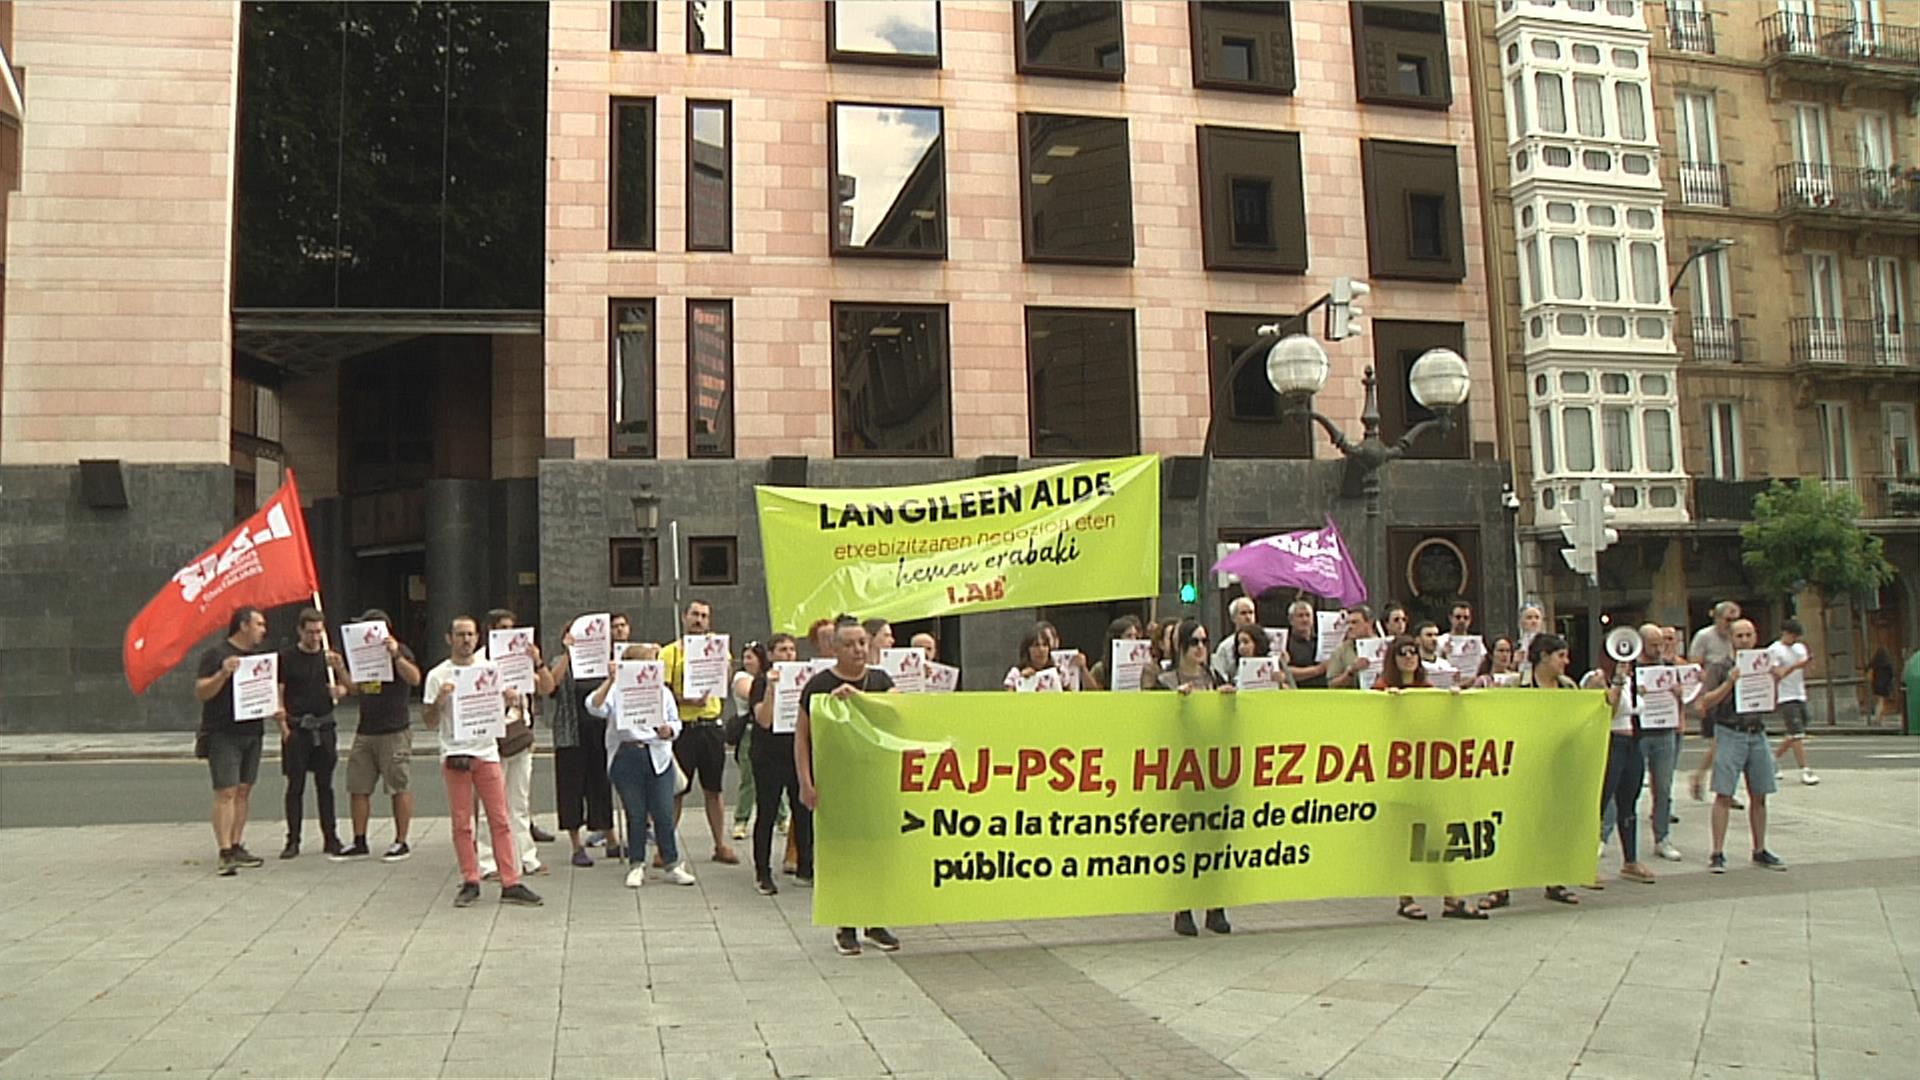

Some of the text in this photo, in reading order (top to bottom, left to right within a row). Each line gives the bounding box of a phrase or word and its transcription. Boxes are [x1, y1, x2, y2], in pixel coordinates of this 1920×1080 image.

[820, 472, 1115, 530] LANGILEEN ALDE
[1075, 514, 1115, 531] eten
[834, 534, 972, 560] etxebizitzaren
[985, 532, 1080, 565] erabaki
[900, 739, 1514, 797] EAJ-PSE, HAU EZ DA BIDEA!
[933, 809, 981, 836] No
[988, 816, 1007, 836] a
[1015, 810, 1042, 835] la
[1049, 804, 1245, 835] transferencia
[1253, 801, 1285, 828] de
[1292, 799, 1376, 824] dinero
[1410, 814, 1500, 863] LAB
[934, 840, 1309, 887] público a manos privadas
